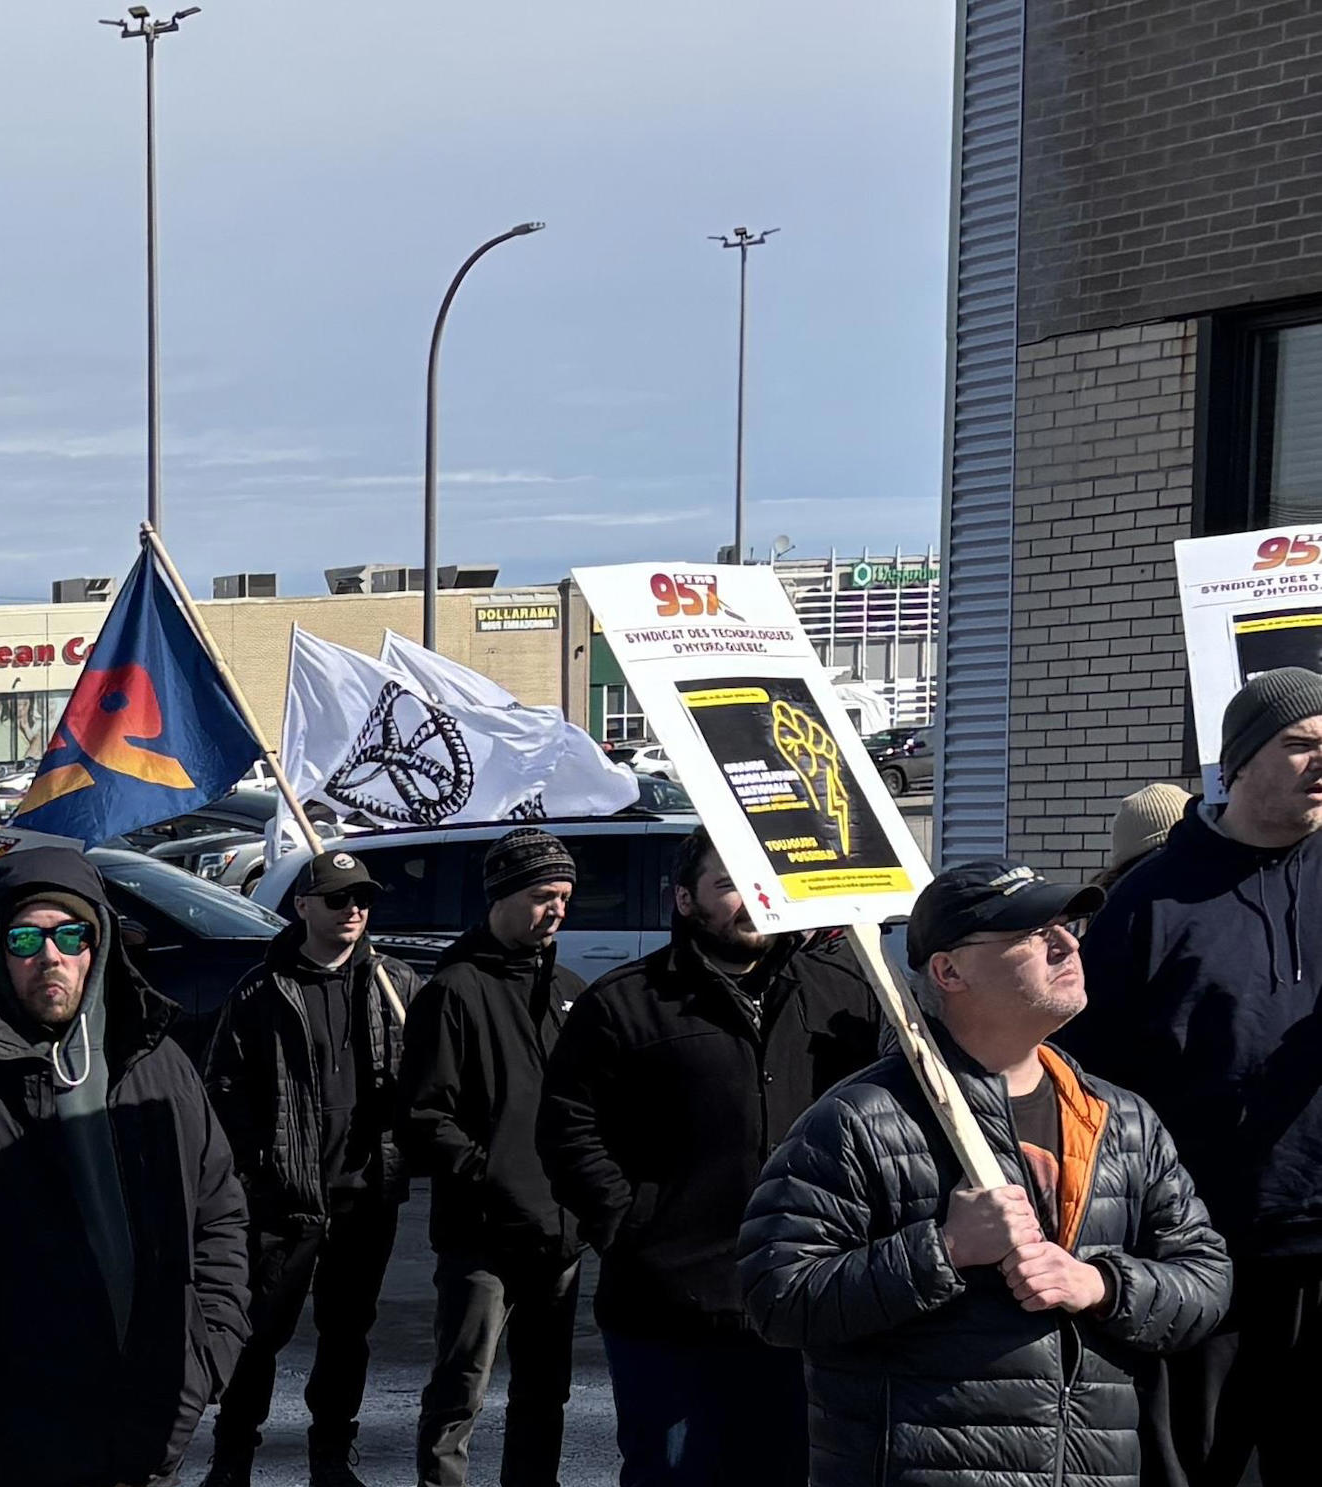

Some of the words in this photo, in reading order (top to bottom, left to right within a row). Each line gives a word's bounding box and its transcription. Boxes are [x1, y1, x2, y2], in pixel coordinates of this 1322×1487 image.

[1201, 577, 1274, 594] SYNDICAT
[1279, 574, 1308, 584] DES
[477, 606, 557, 621] DOLLARAMA
[625, 629, 685, 644] SYNDICAT
